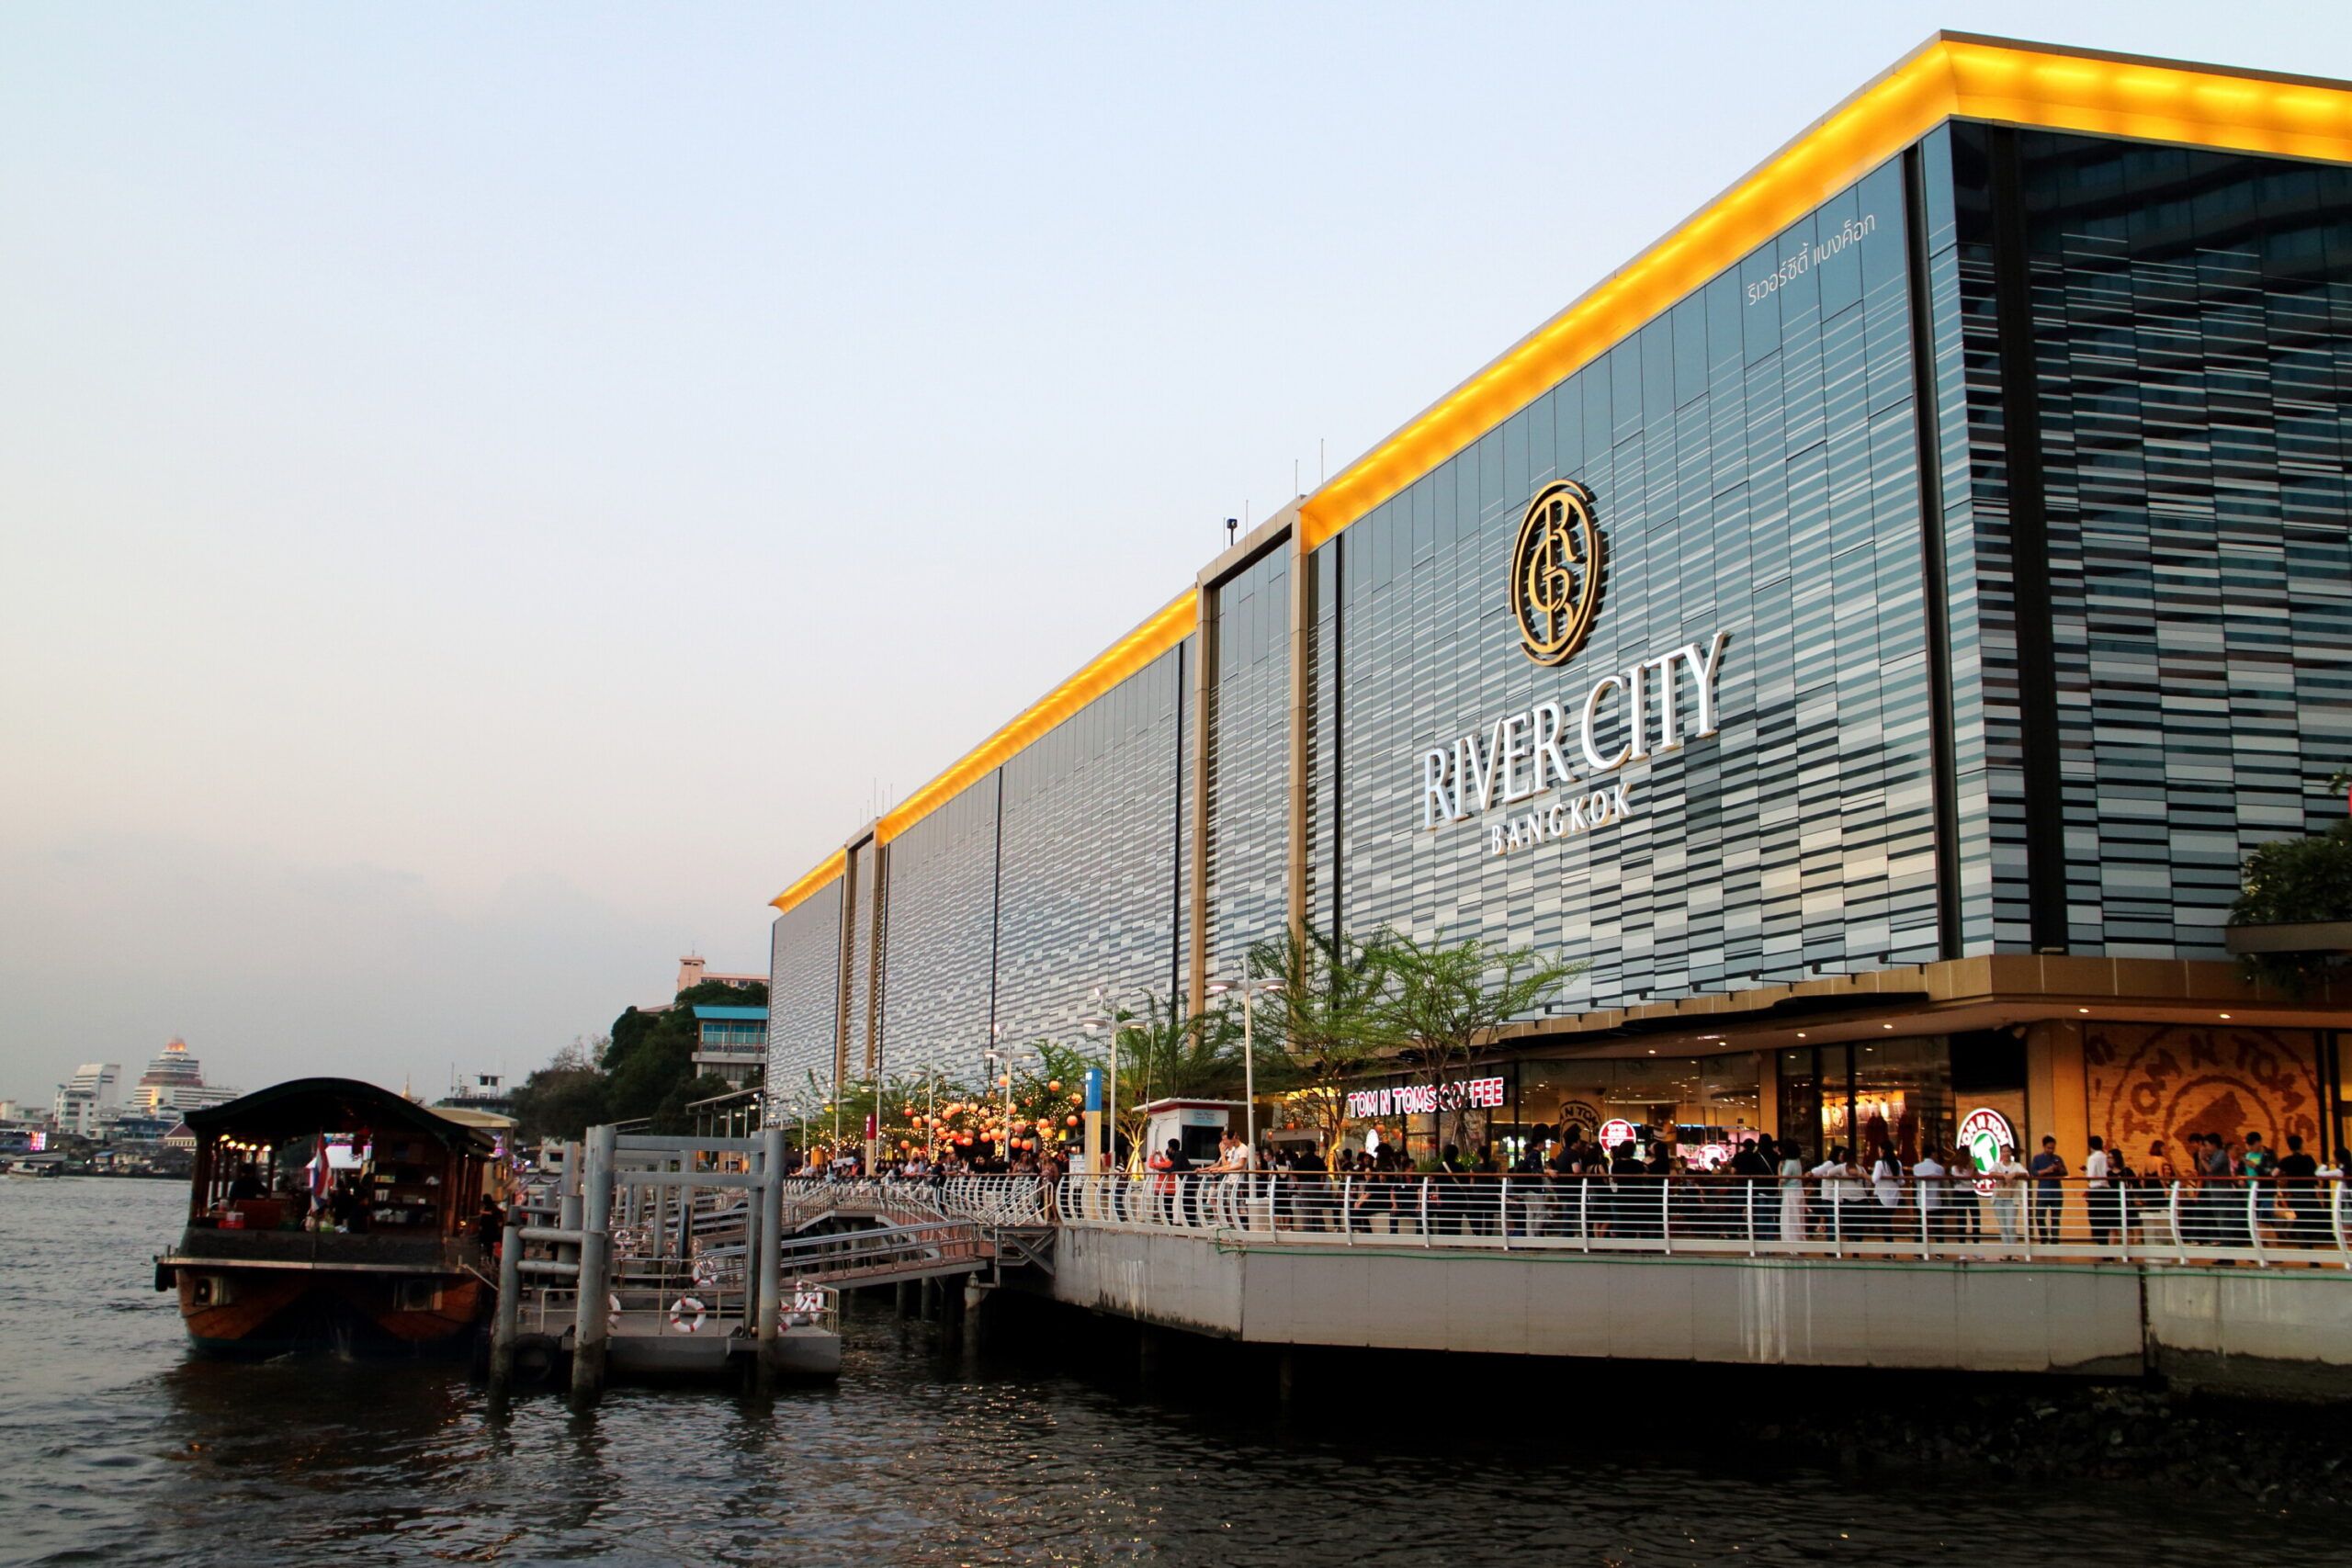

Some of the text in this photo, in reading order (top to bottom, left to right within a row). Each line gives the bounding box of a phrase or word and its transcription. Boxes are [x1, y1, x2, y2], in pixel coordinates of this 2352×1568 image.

[1814, 214, 1875, 266] แบงค็อก
[1422, 631, 1728, 831] RIVER CITY
[1491, 783, 1635, 855] BANGKOK
[2188, 1032, 2222, 1070] N
[1347, 1090, 1378, 1118] TOM
[1380, 1089, 1391, 1116] N
[1392, 1084, 1437, 1115] TOMS
